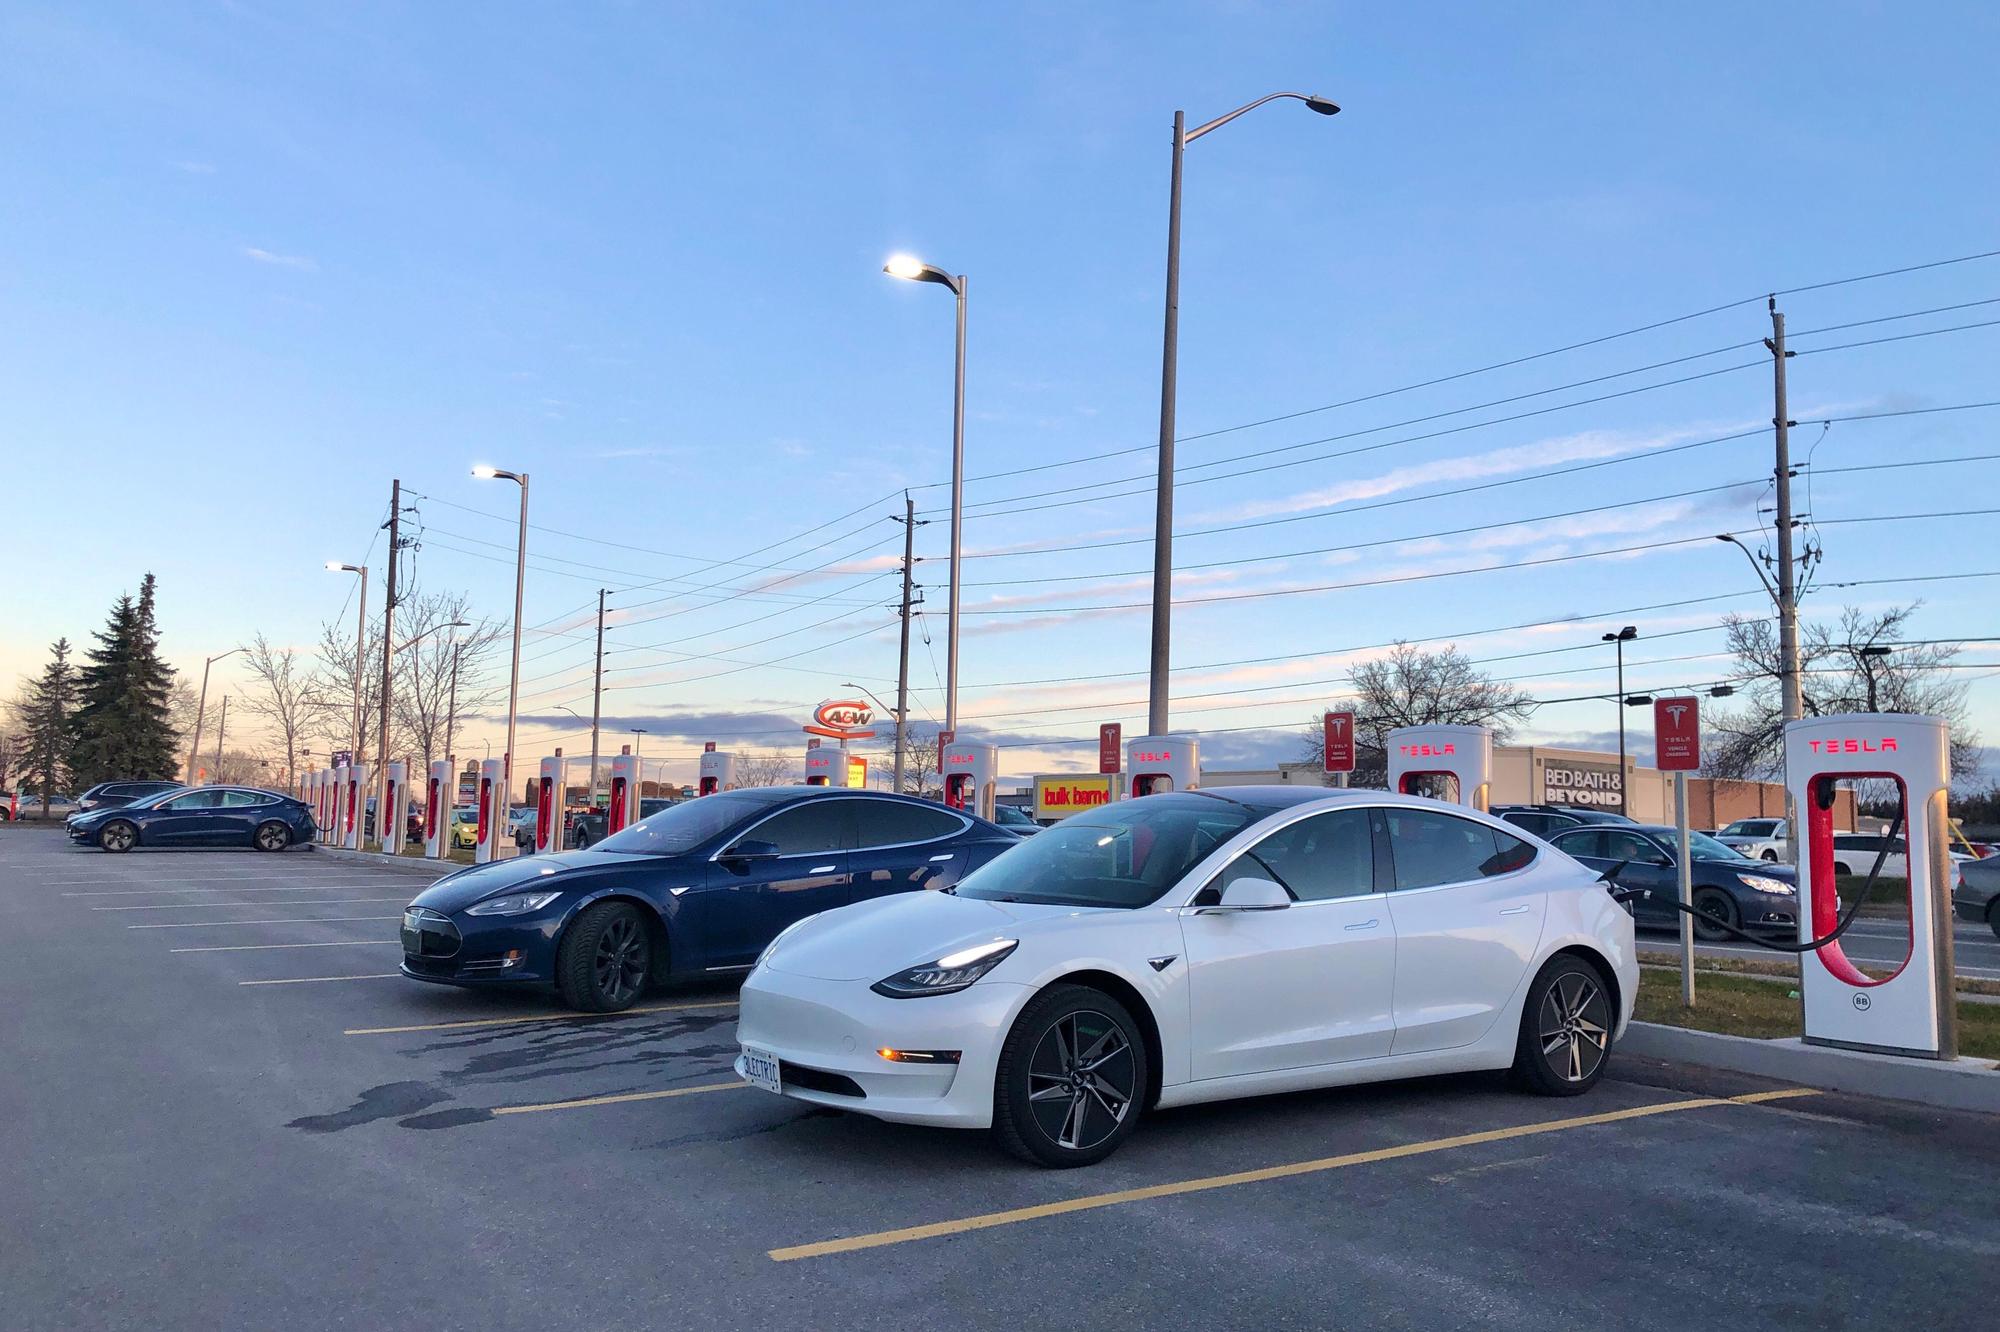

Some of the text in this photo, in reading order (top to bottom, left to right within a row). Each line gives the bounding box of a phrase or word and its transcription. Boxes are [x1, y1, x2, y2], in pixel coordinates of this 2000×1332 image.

[827, 710, 872, 725] A&W
[1400, 743, 1455, 756] TESLA
[1808, 738, 1897, 754] TESLA
[1134, 751, 1171, 762] TESLA
[1545, 768, 1621, 790] BED BATH &
[1044, 786, 1102, 806] bulk barn
[1546, 788, 1622, 806] BEYOND
